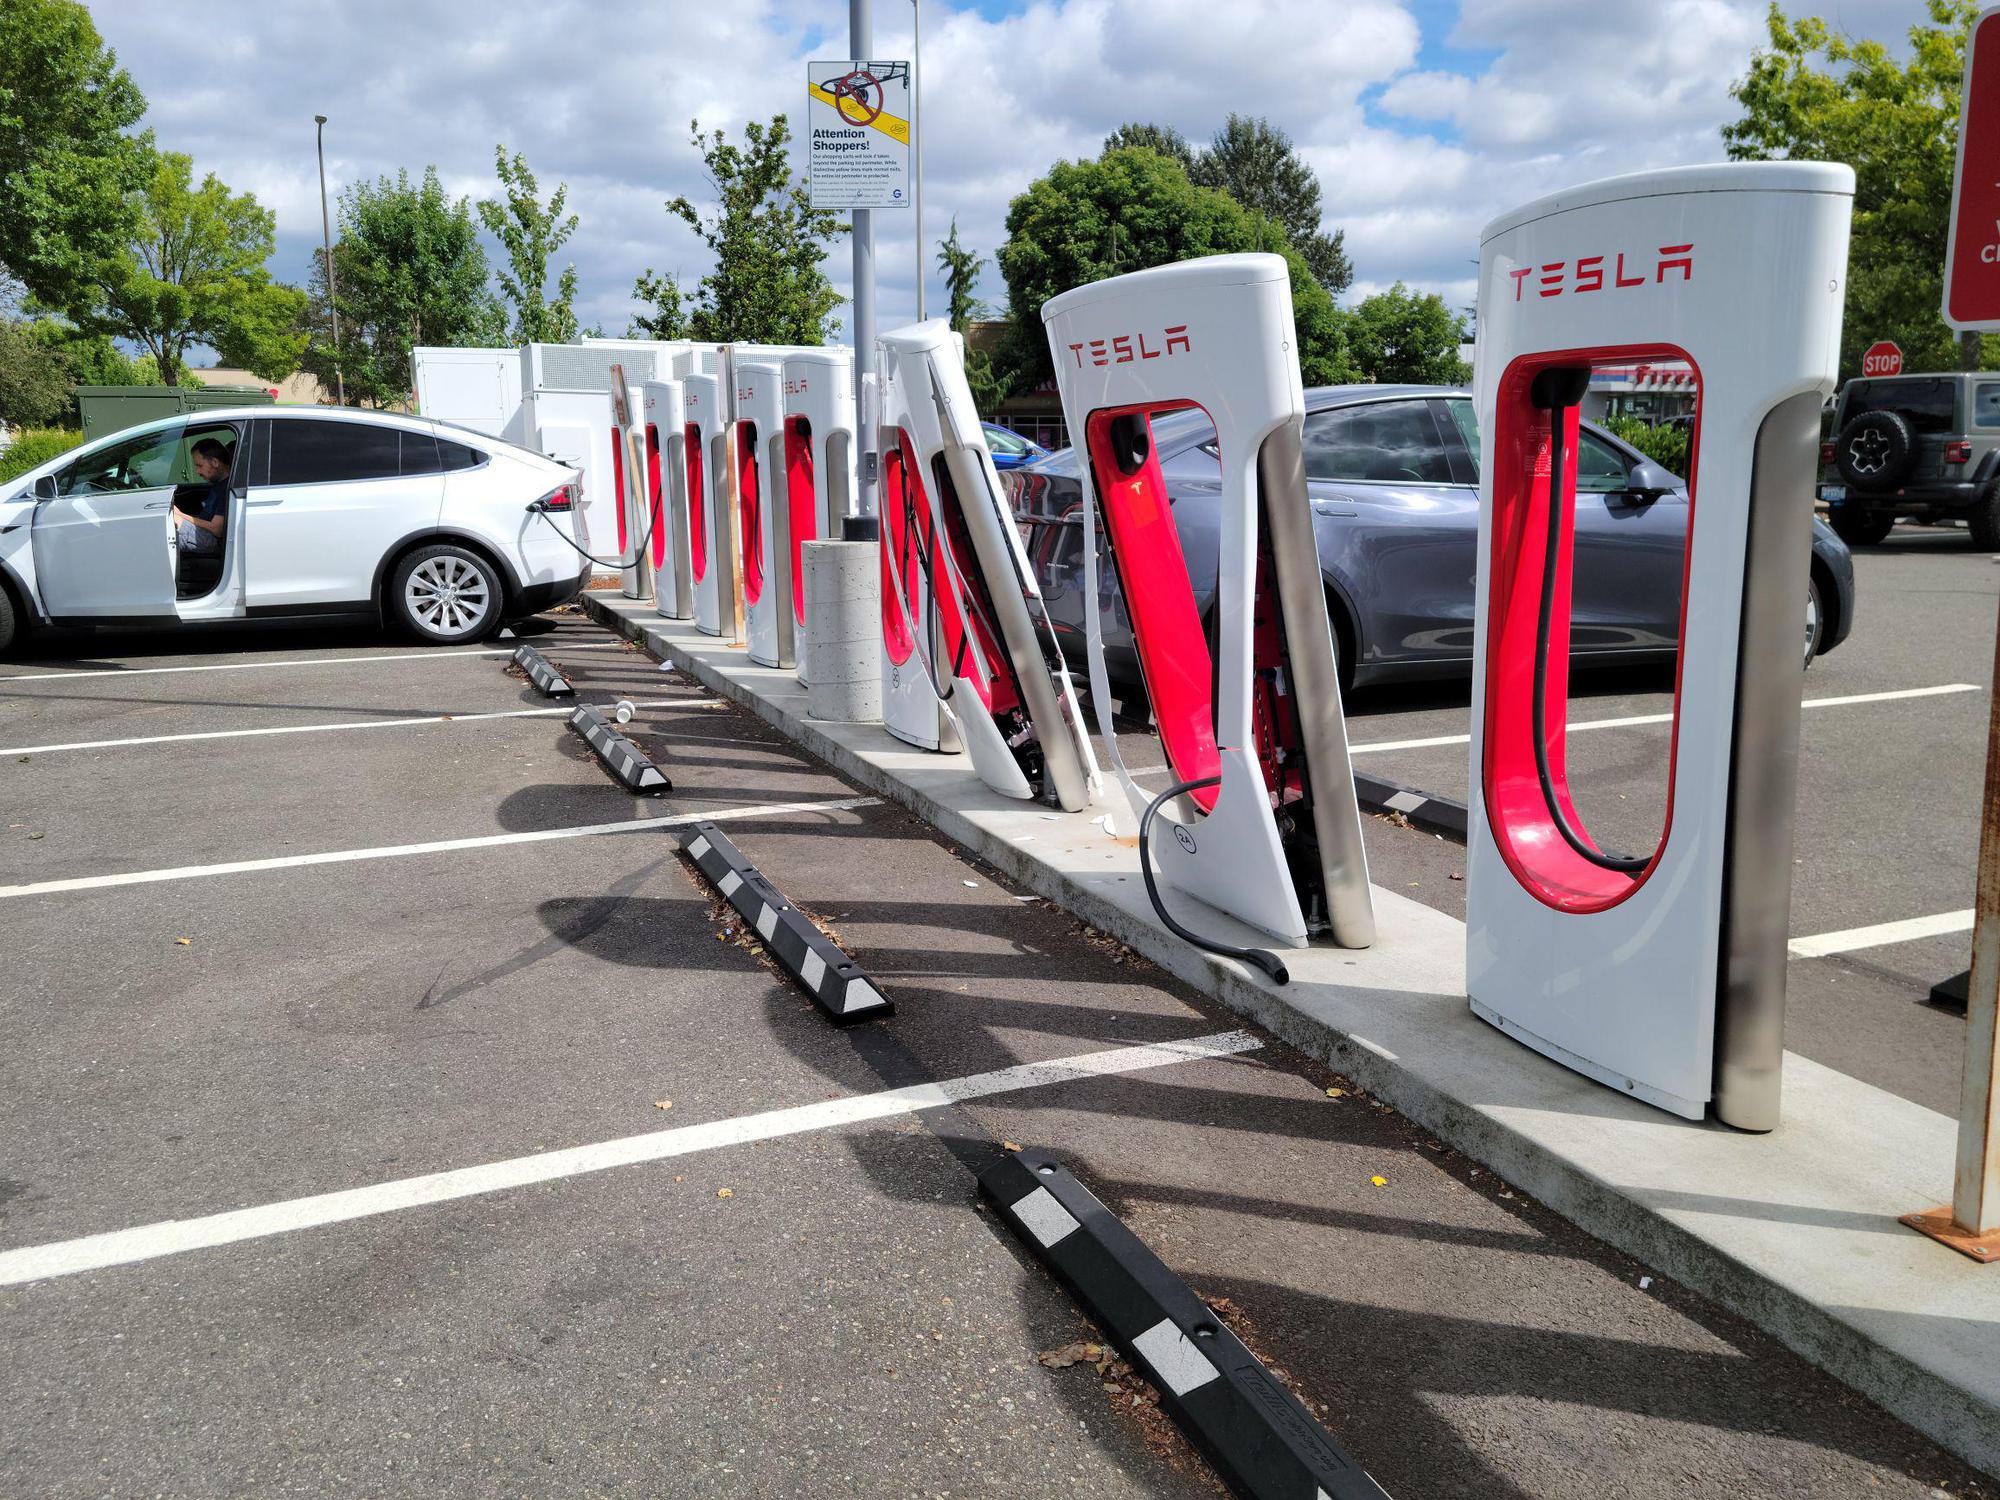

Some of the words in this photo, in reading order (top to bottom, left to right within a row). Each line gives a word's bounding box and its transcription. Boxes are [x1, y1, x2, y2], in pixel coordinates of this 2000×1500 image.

[813, 128, 865, 139] Attention
[813, 140, 870, 152] Shoppers!
[1509, 244, 1694, 302] TESLA
[1068, 325, 1191, 369] TESLA
[1866, 355, 1900, 373] STOP
